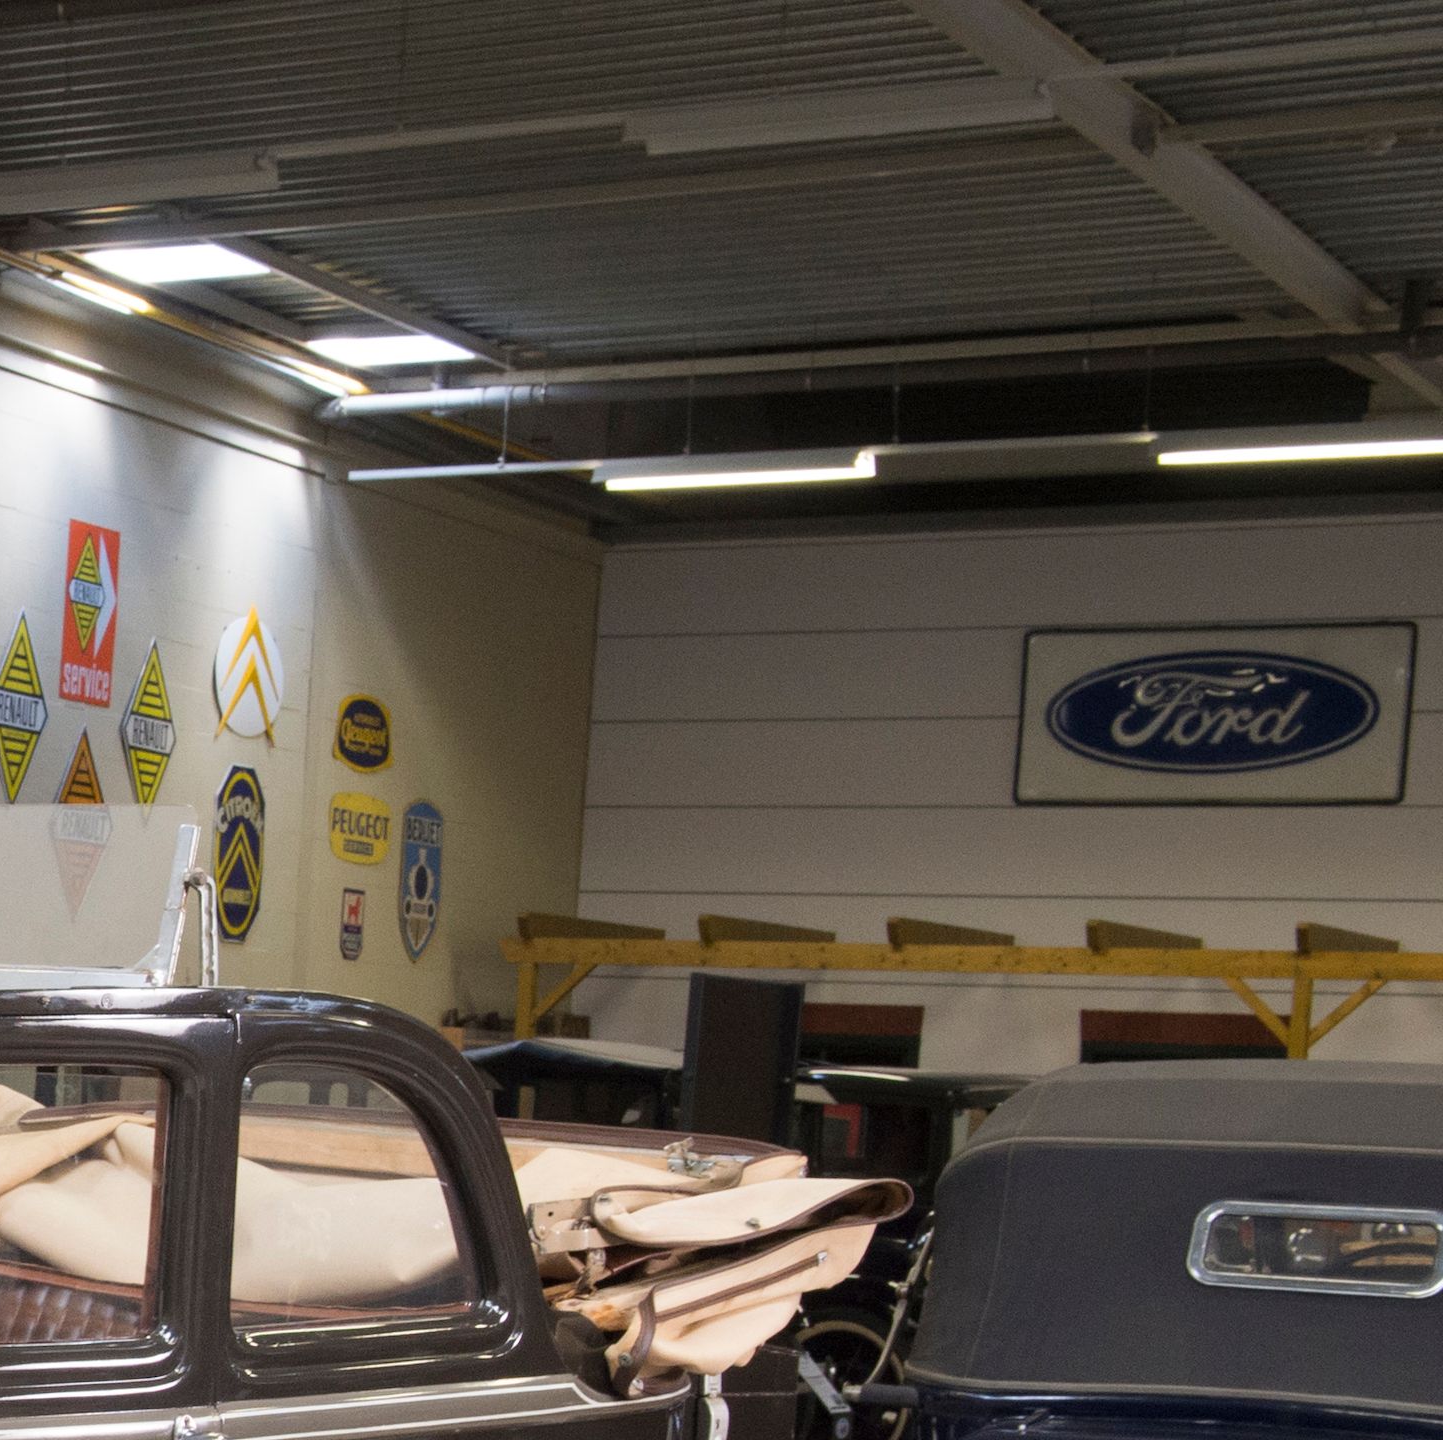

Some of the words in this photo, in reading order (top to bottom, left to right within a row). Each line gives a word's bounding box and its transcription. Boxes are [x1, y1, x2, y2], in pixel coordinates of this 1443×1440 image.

[63, 661, 110, 701] service
[1111, 669, 1312, 748] Ford
[132, 717, 169, 751] RENAULT
[332, 807, 390, 841] PEUGEOT
